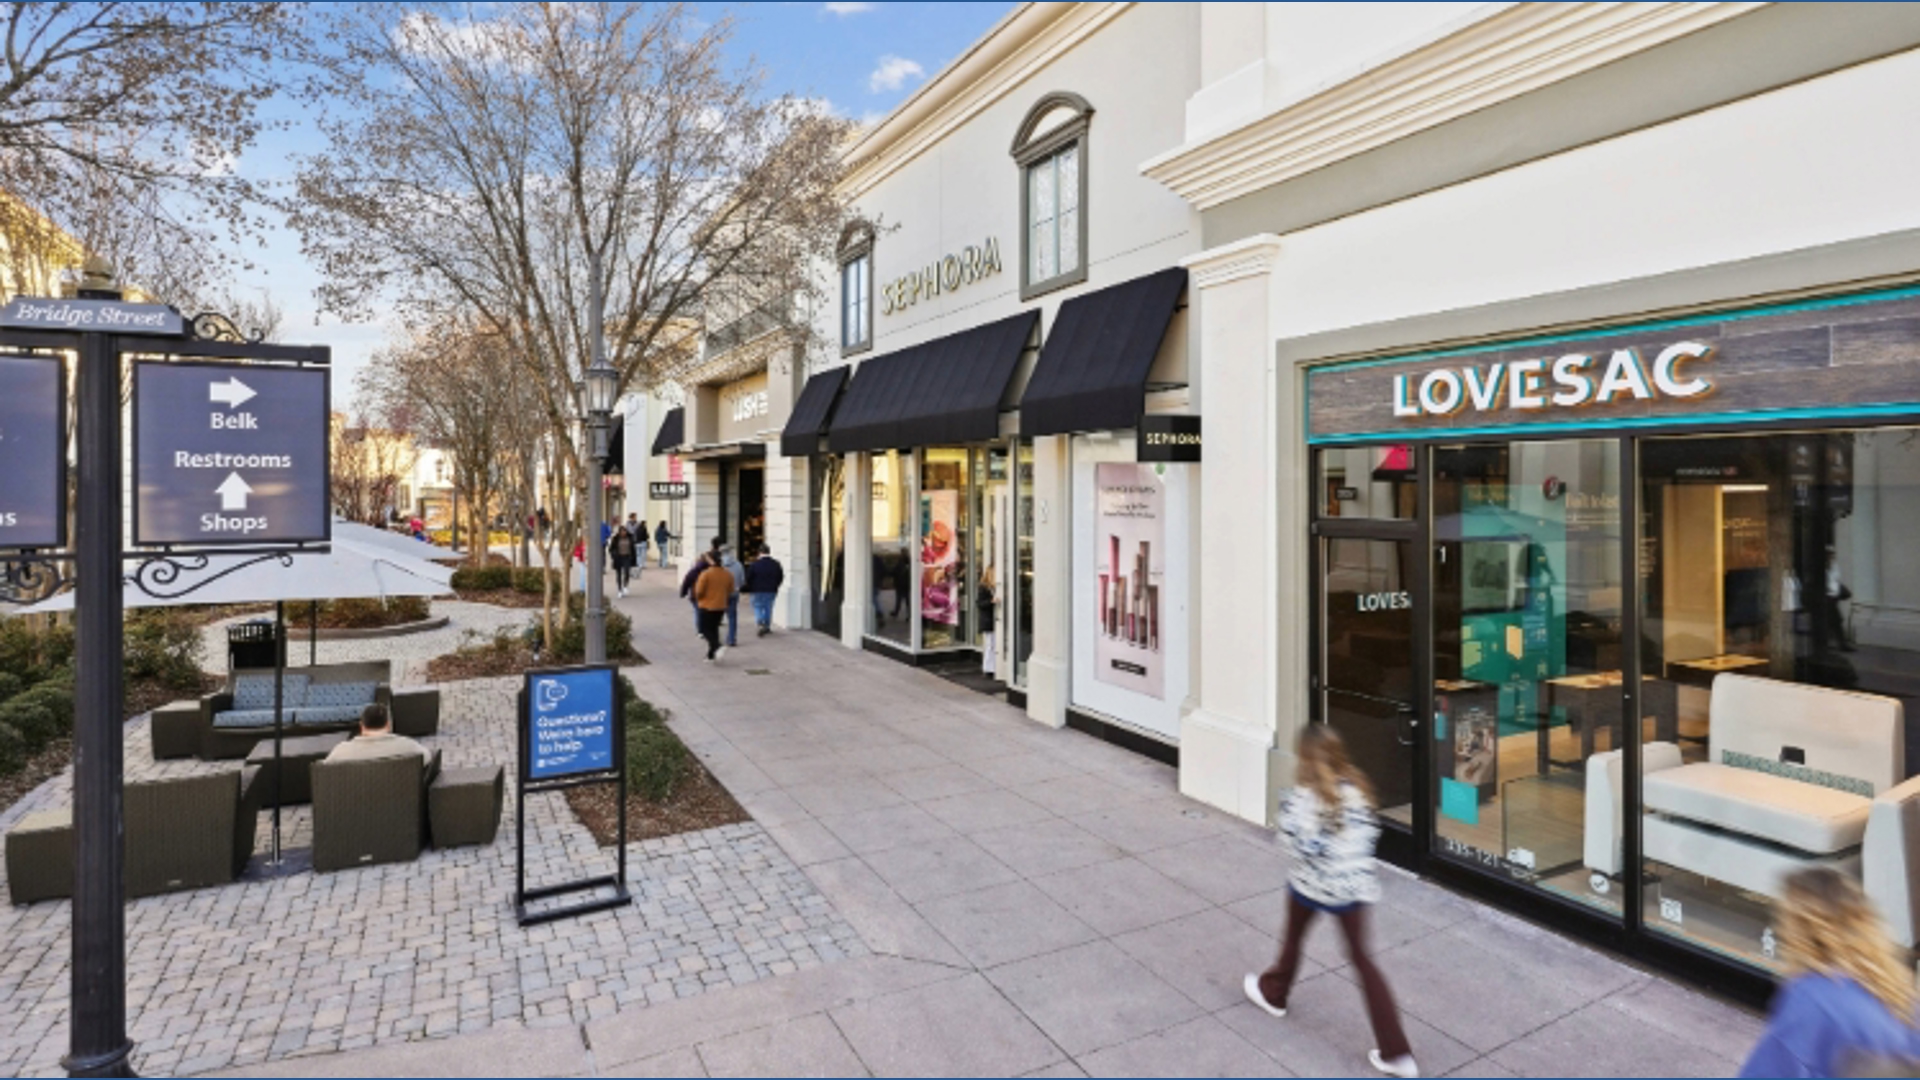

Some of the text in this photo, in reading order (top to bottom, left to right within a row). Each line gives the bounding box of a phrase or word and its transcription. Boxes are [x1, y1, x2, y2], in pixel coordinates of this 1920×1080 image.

[881, 236, 1002, 315] SEPHORA
[15, 302, 165, 327] Bridge Street
[1392, 341, 1712, 418] LOVESAC
[210, 412, 258, 430] Belk
[1146, 432, 1201, 445] SEPHORA
[174, 451, 291, 469] Restrooms
[200, 514, 268, 534] Shops
[1357, 592, 1412, 611] LOVES
[538, 710, 606, 726] Questions?
[576, 726, 604, 737] here
[538, 740, 583, 755] to help
